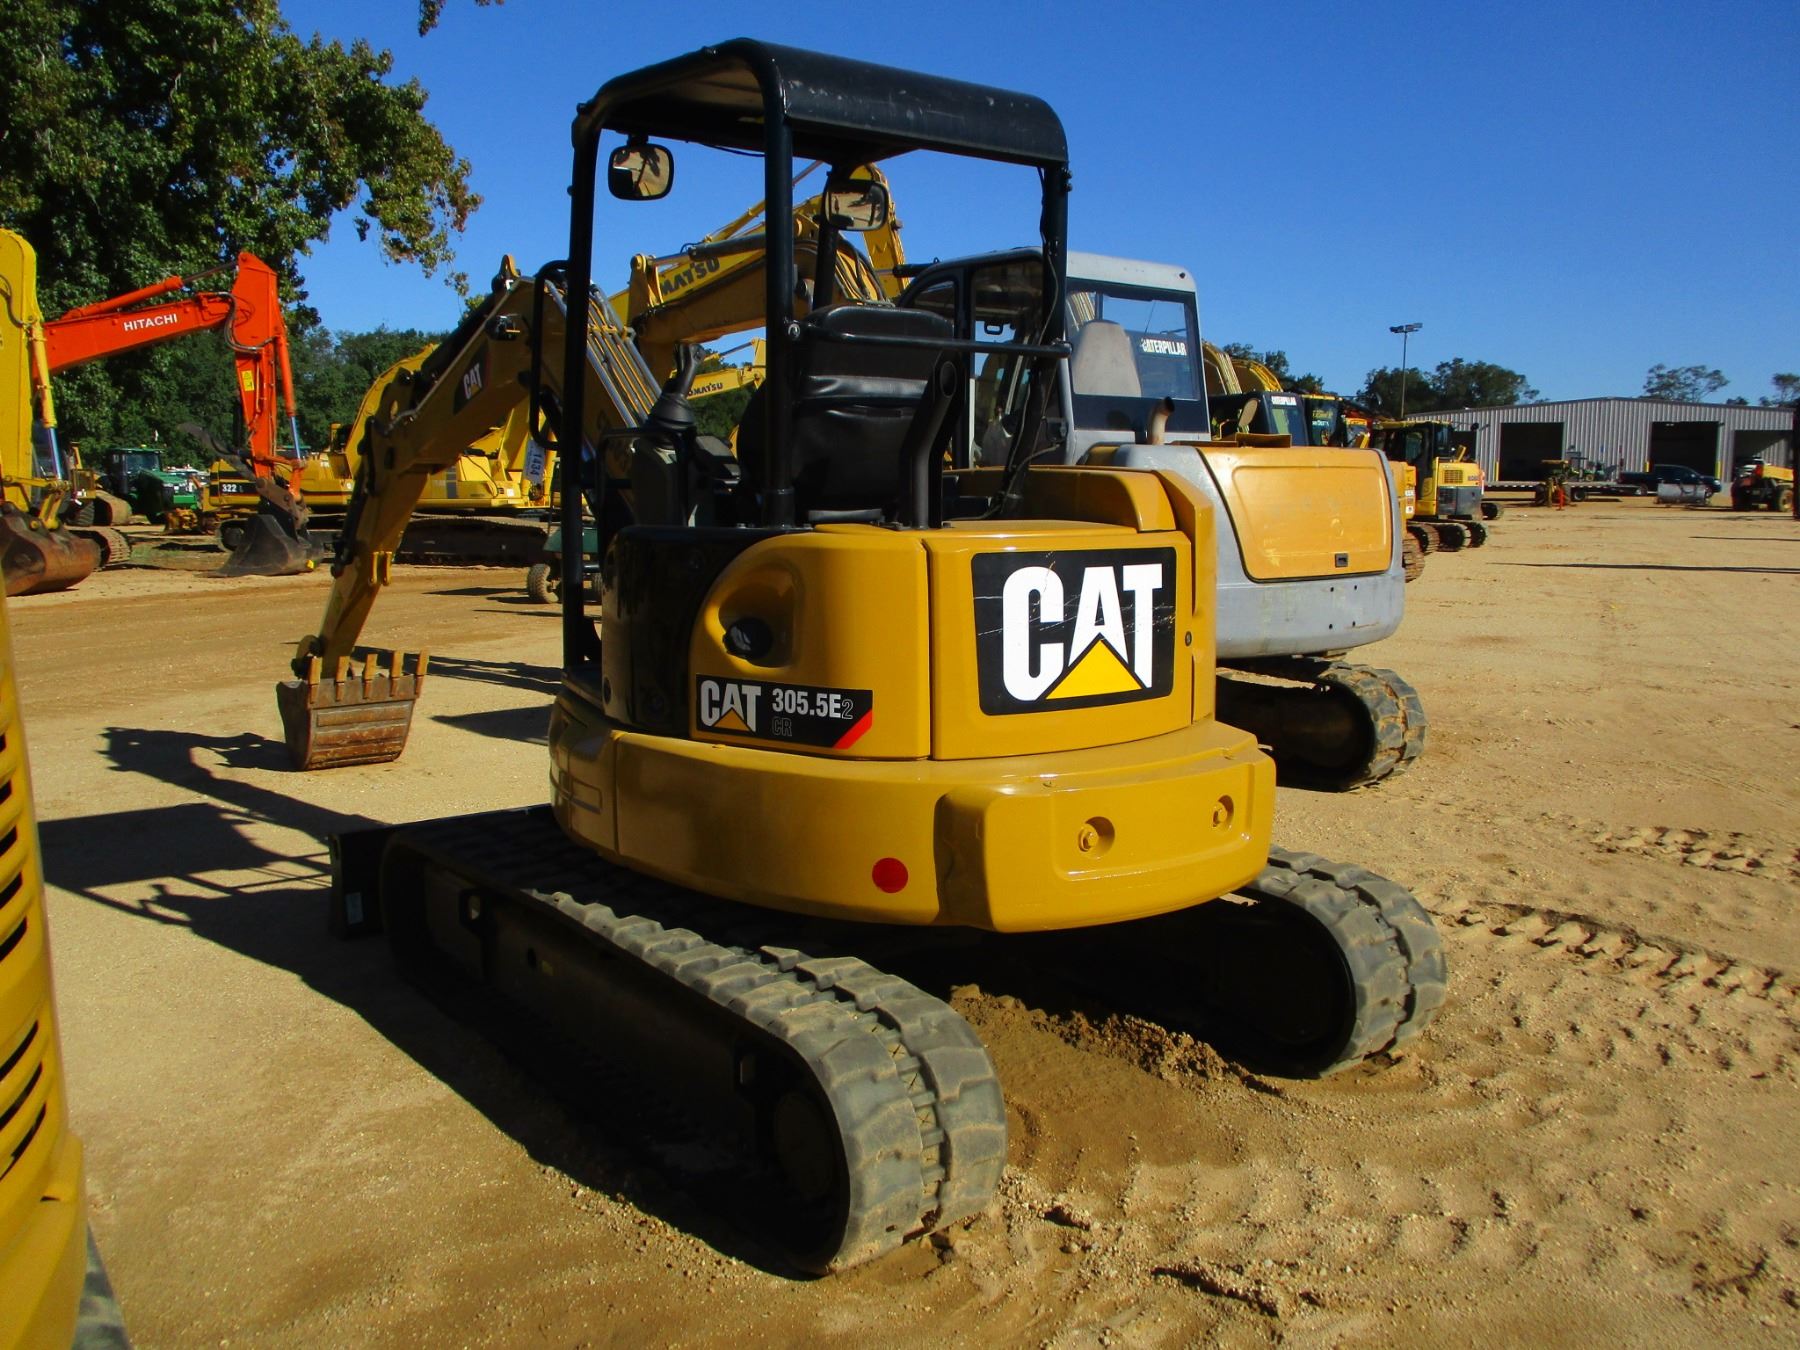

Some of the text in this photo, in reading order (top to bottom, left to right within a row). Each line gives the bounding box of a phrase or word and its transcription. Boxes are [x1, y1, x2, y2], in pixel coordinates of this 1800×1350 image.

[123, 313, 178, 331] HITACHI
[1140, 337, 1188, 356] CATERPILLAR
[463, 362, 482, 400] CAT
[222, 483, 238, 493] 322
[1002, 562, 1163, 702] CAT
[700, 679, 762, 733] CAT
[771, 687, 854, 720] 305.5E2
[771, 715, 793, 738] CR
